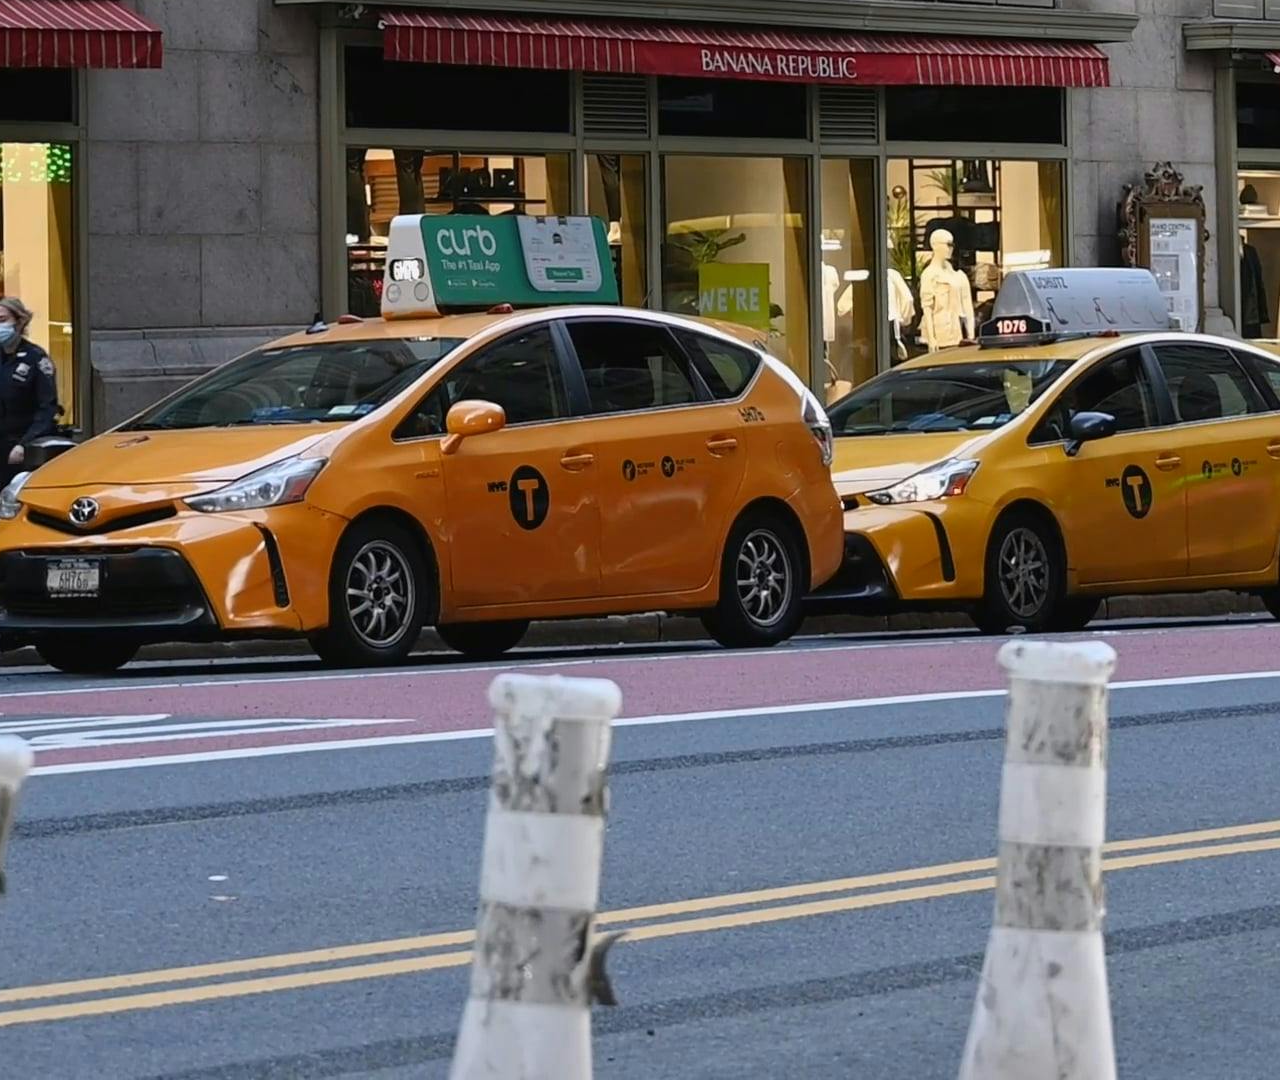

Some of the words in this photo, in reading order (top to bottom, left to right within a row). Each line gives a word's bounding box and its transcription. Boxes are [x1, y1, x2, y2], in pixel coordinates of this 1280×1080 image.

[701, 49, 774, 75] BANANA
[777, 55, 857, 78] REPUBLIC
[436, 224, 497, 256] curb
[440, 259, 457, 270] The
[467, 259, 484, 271] Taxi
[485, 260, 501, 272] App
[699, 287, 760, 313] WE'RE
[996, 320, 1027, 335] 1D76
[517, 479, 539, 521] T
